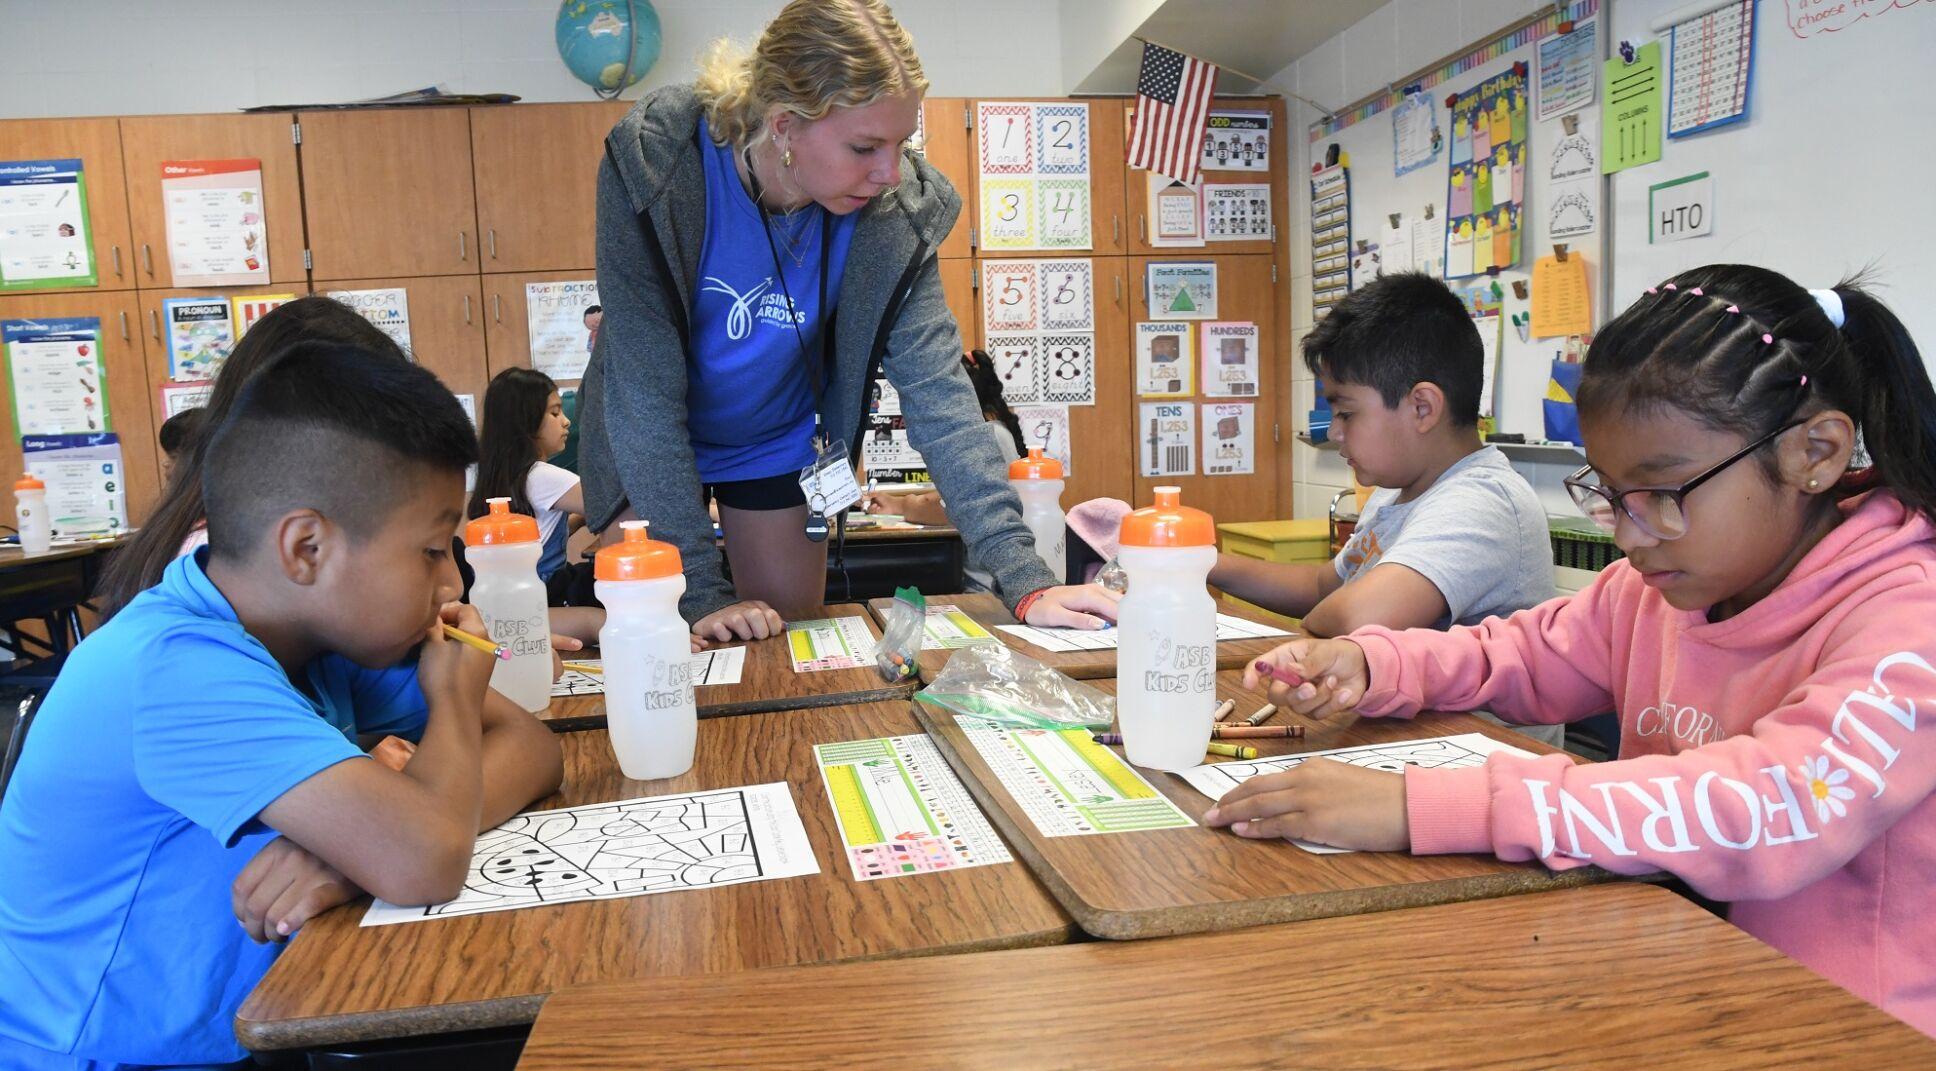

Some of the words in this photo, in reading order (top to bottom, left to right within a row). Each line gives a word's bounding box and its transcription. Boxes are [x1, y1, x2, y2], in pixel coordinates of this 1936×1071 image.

[1209, 118, 1231, 127] ODD
[1052, 120, 1073, 149] 2
[1214, 190, 1246, 198] FRIENDS
[996, 194, 1019, 221] 3
[1052, 192, 1075, 224] 4
[1662, 203, 1703, 236] HTO
[994, 226, 1026, 237] three
[999, 276, 1028, 306] 5
[1053, 274, 1075, 304] 6
[760, 294, 795, 309] RISING
[178, 306, 222, 316] PRONOUN
[360, 309, 400, 320] TTOM
[755, 306, 806, 324] ARROWS
[1140, 324, 1187, 332] THOUSANDS
[1211, 327, 1255, 336] HUNDREDS
[1005, 351, 1029, 380] 7
[1054, 347, 1082, 380] 8
[1156, 406, 1182, 417] TENS
[26, 441, 45, 449] Long
[104, 481, 115, 492] e
[494, 619, 529, 639] ASB
[1174, 645, 1210, 669] ASB
